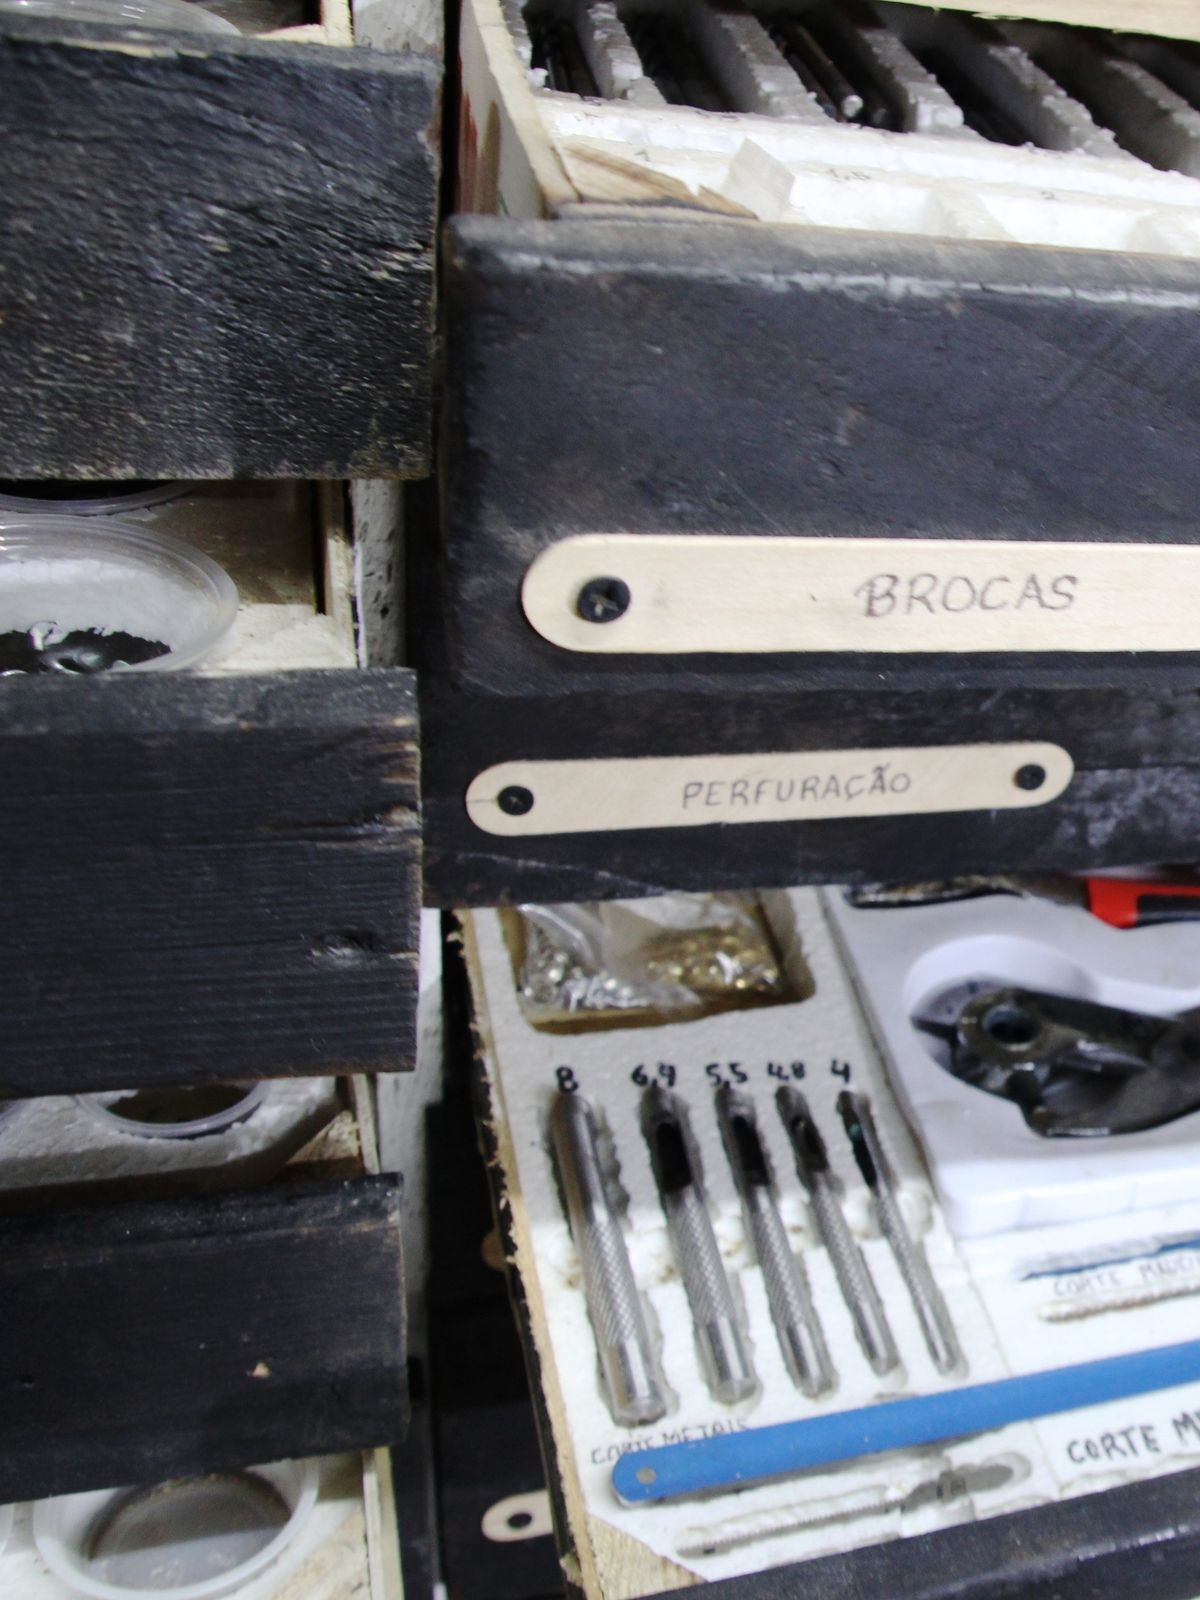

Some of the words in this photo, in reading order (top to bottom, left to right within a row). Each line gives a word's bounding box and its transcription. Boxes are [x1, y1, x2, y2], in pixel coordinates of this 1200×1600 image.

[853, 572, 1079, 618] BROCAS
[681, 762, 912, 809] PERFURAÇÃO
[554, 1065, 580, 1093] 8
[705, 1062, 749, 1089] 5,5
[829, 1059, 851, 1083] 4
[1065, 1422, 1162, 1465] CORTE
